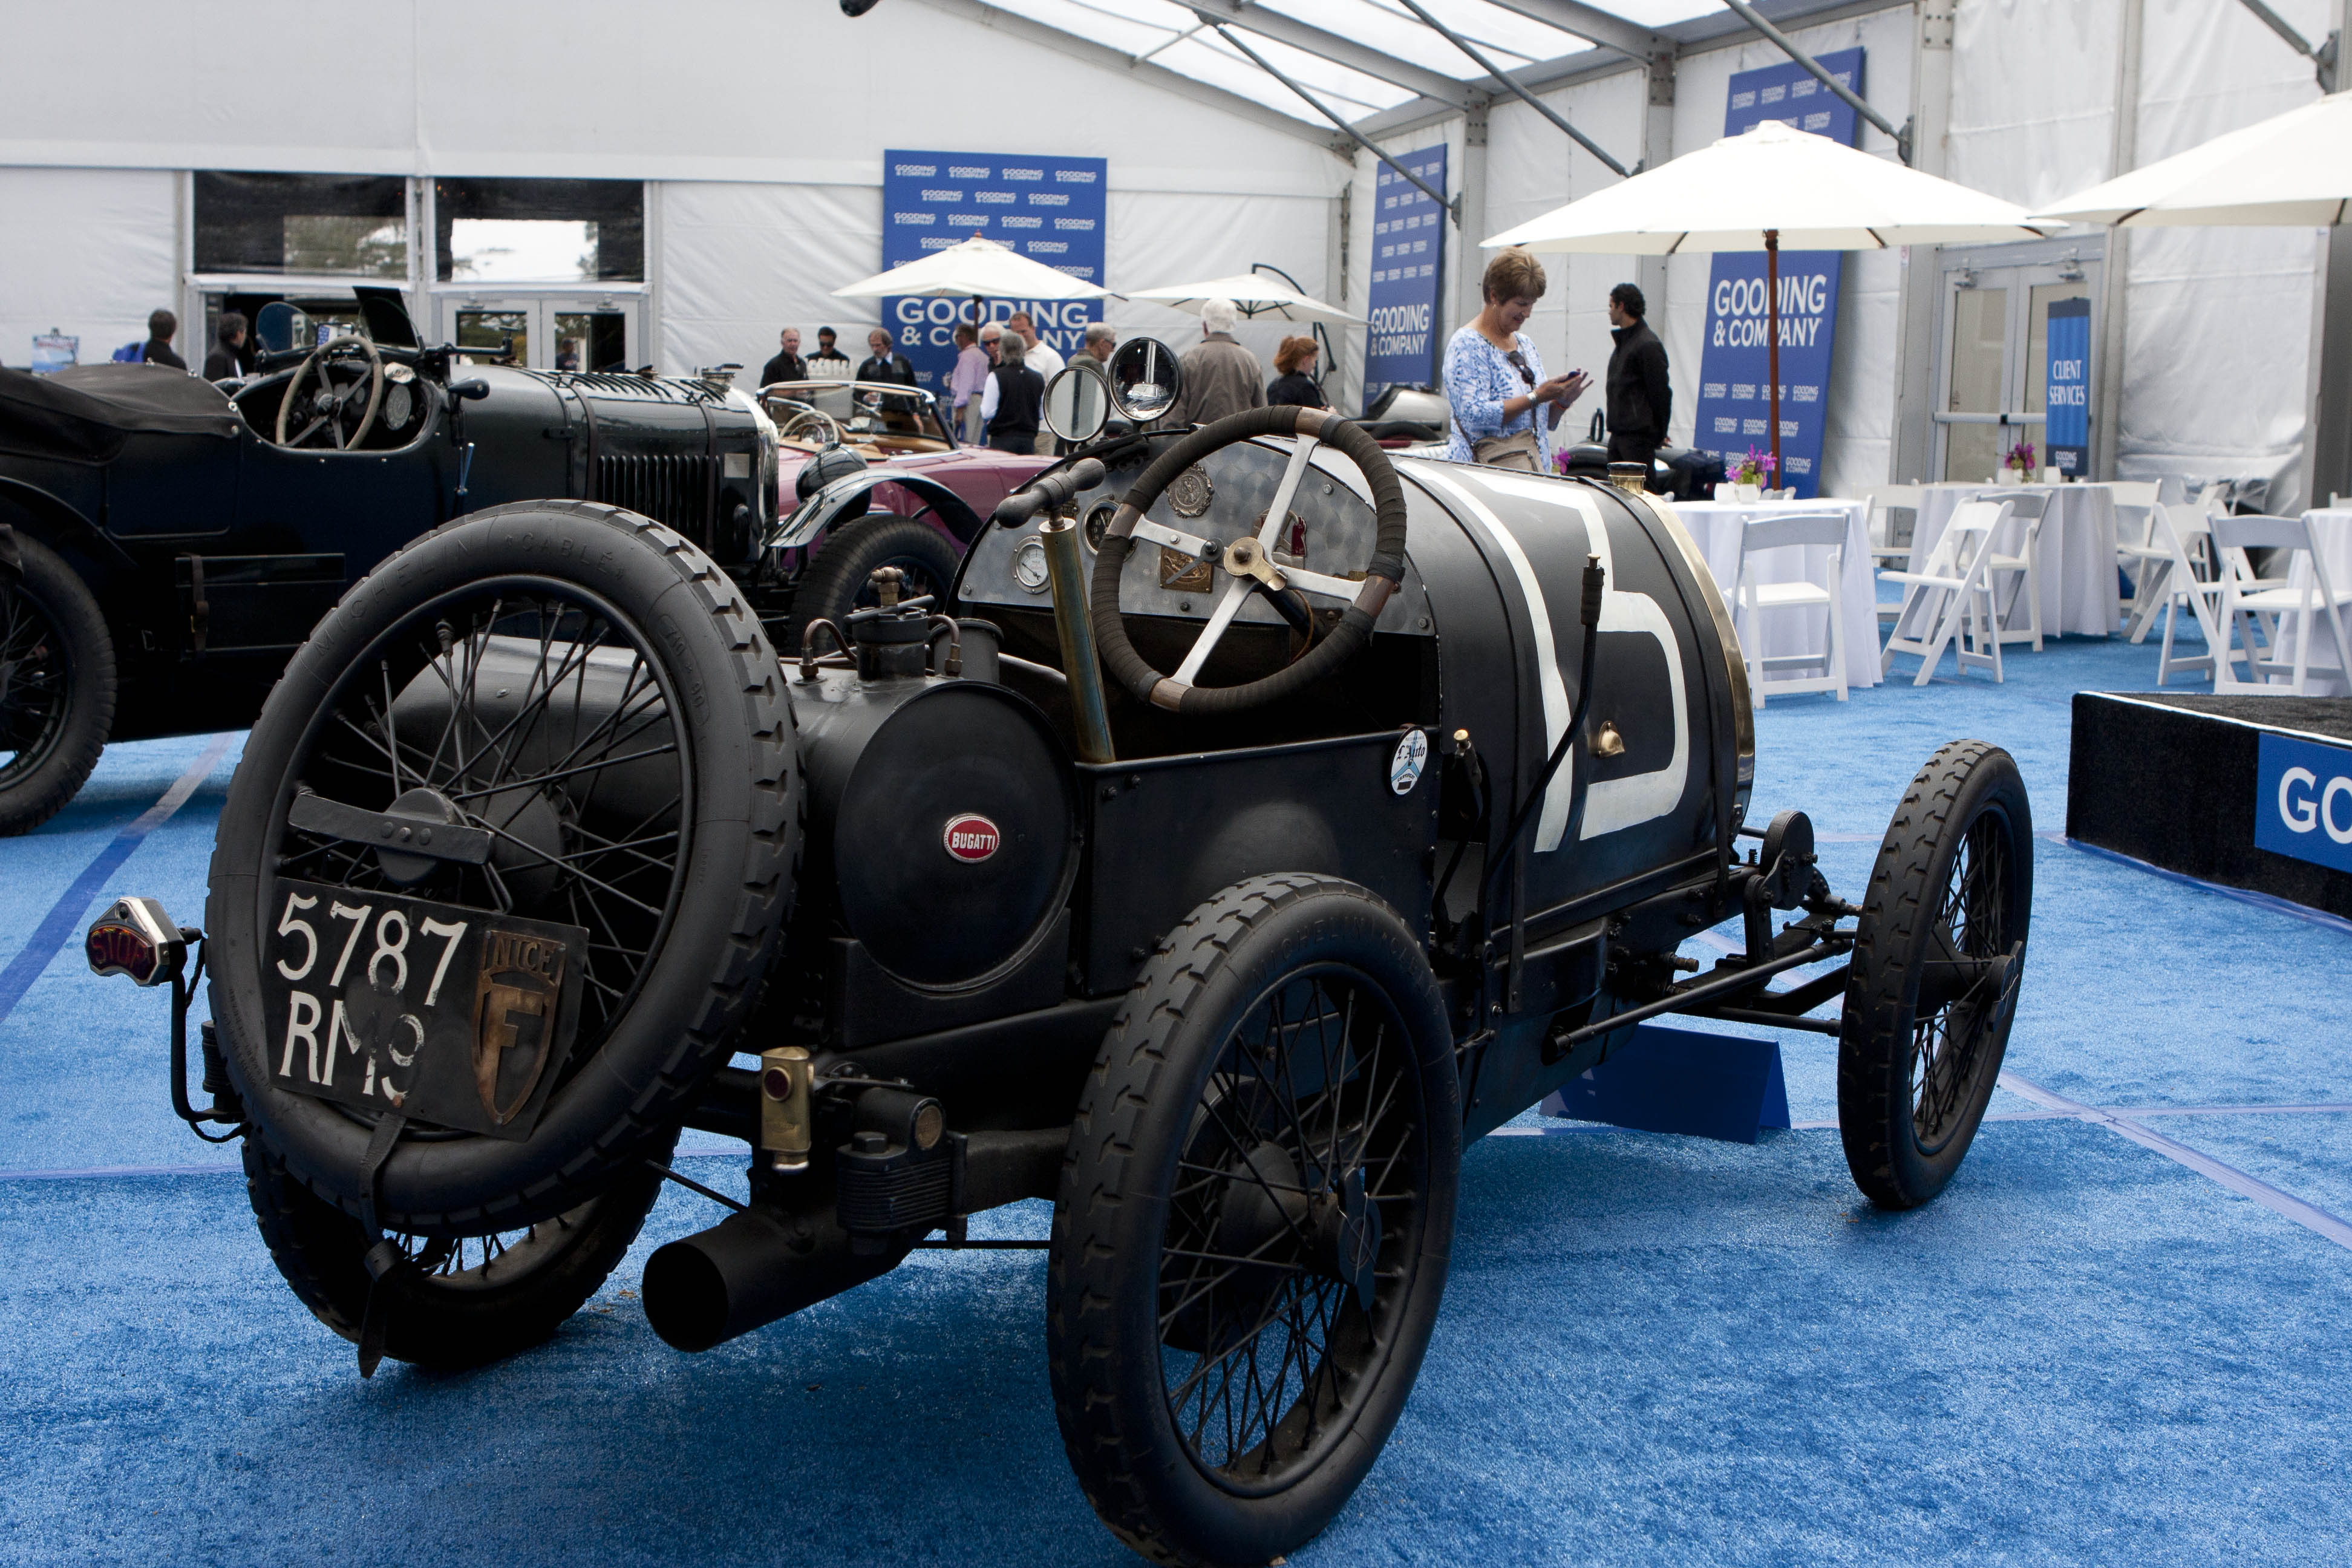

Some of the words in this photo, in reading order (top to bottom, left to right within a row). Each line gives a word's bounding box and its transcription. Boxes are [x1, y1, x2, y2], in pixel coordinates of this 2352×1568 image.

[1371, 304, 1429, 334] GOODING
[1713, 319, 1725, 347] &
[901, 326, 921, 345] &
[1379, 334, 1428, 356] COMPANY
[2053, 360, 2082, 381] CLIENT
[2049, 385, 2085, 406] SERVICES
[316, 537, 473, 657] MICHELIN
[2279, 766, 2352, 844] GO
[952, 832, 996, 850] BUGATTI
[276, 892, 468, 1007] 5787
[492, 937, 557, 976] NICE
